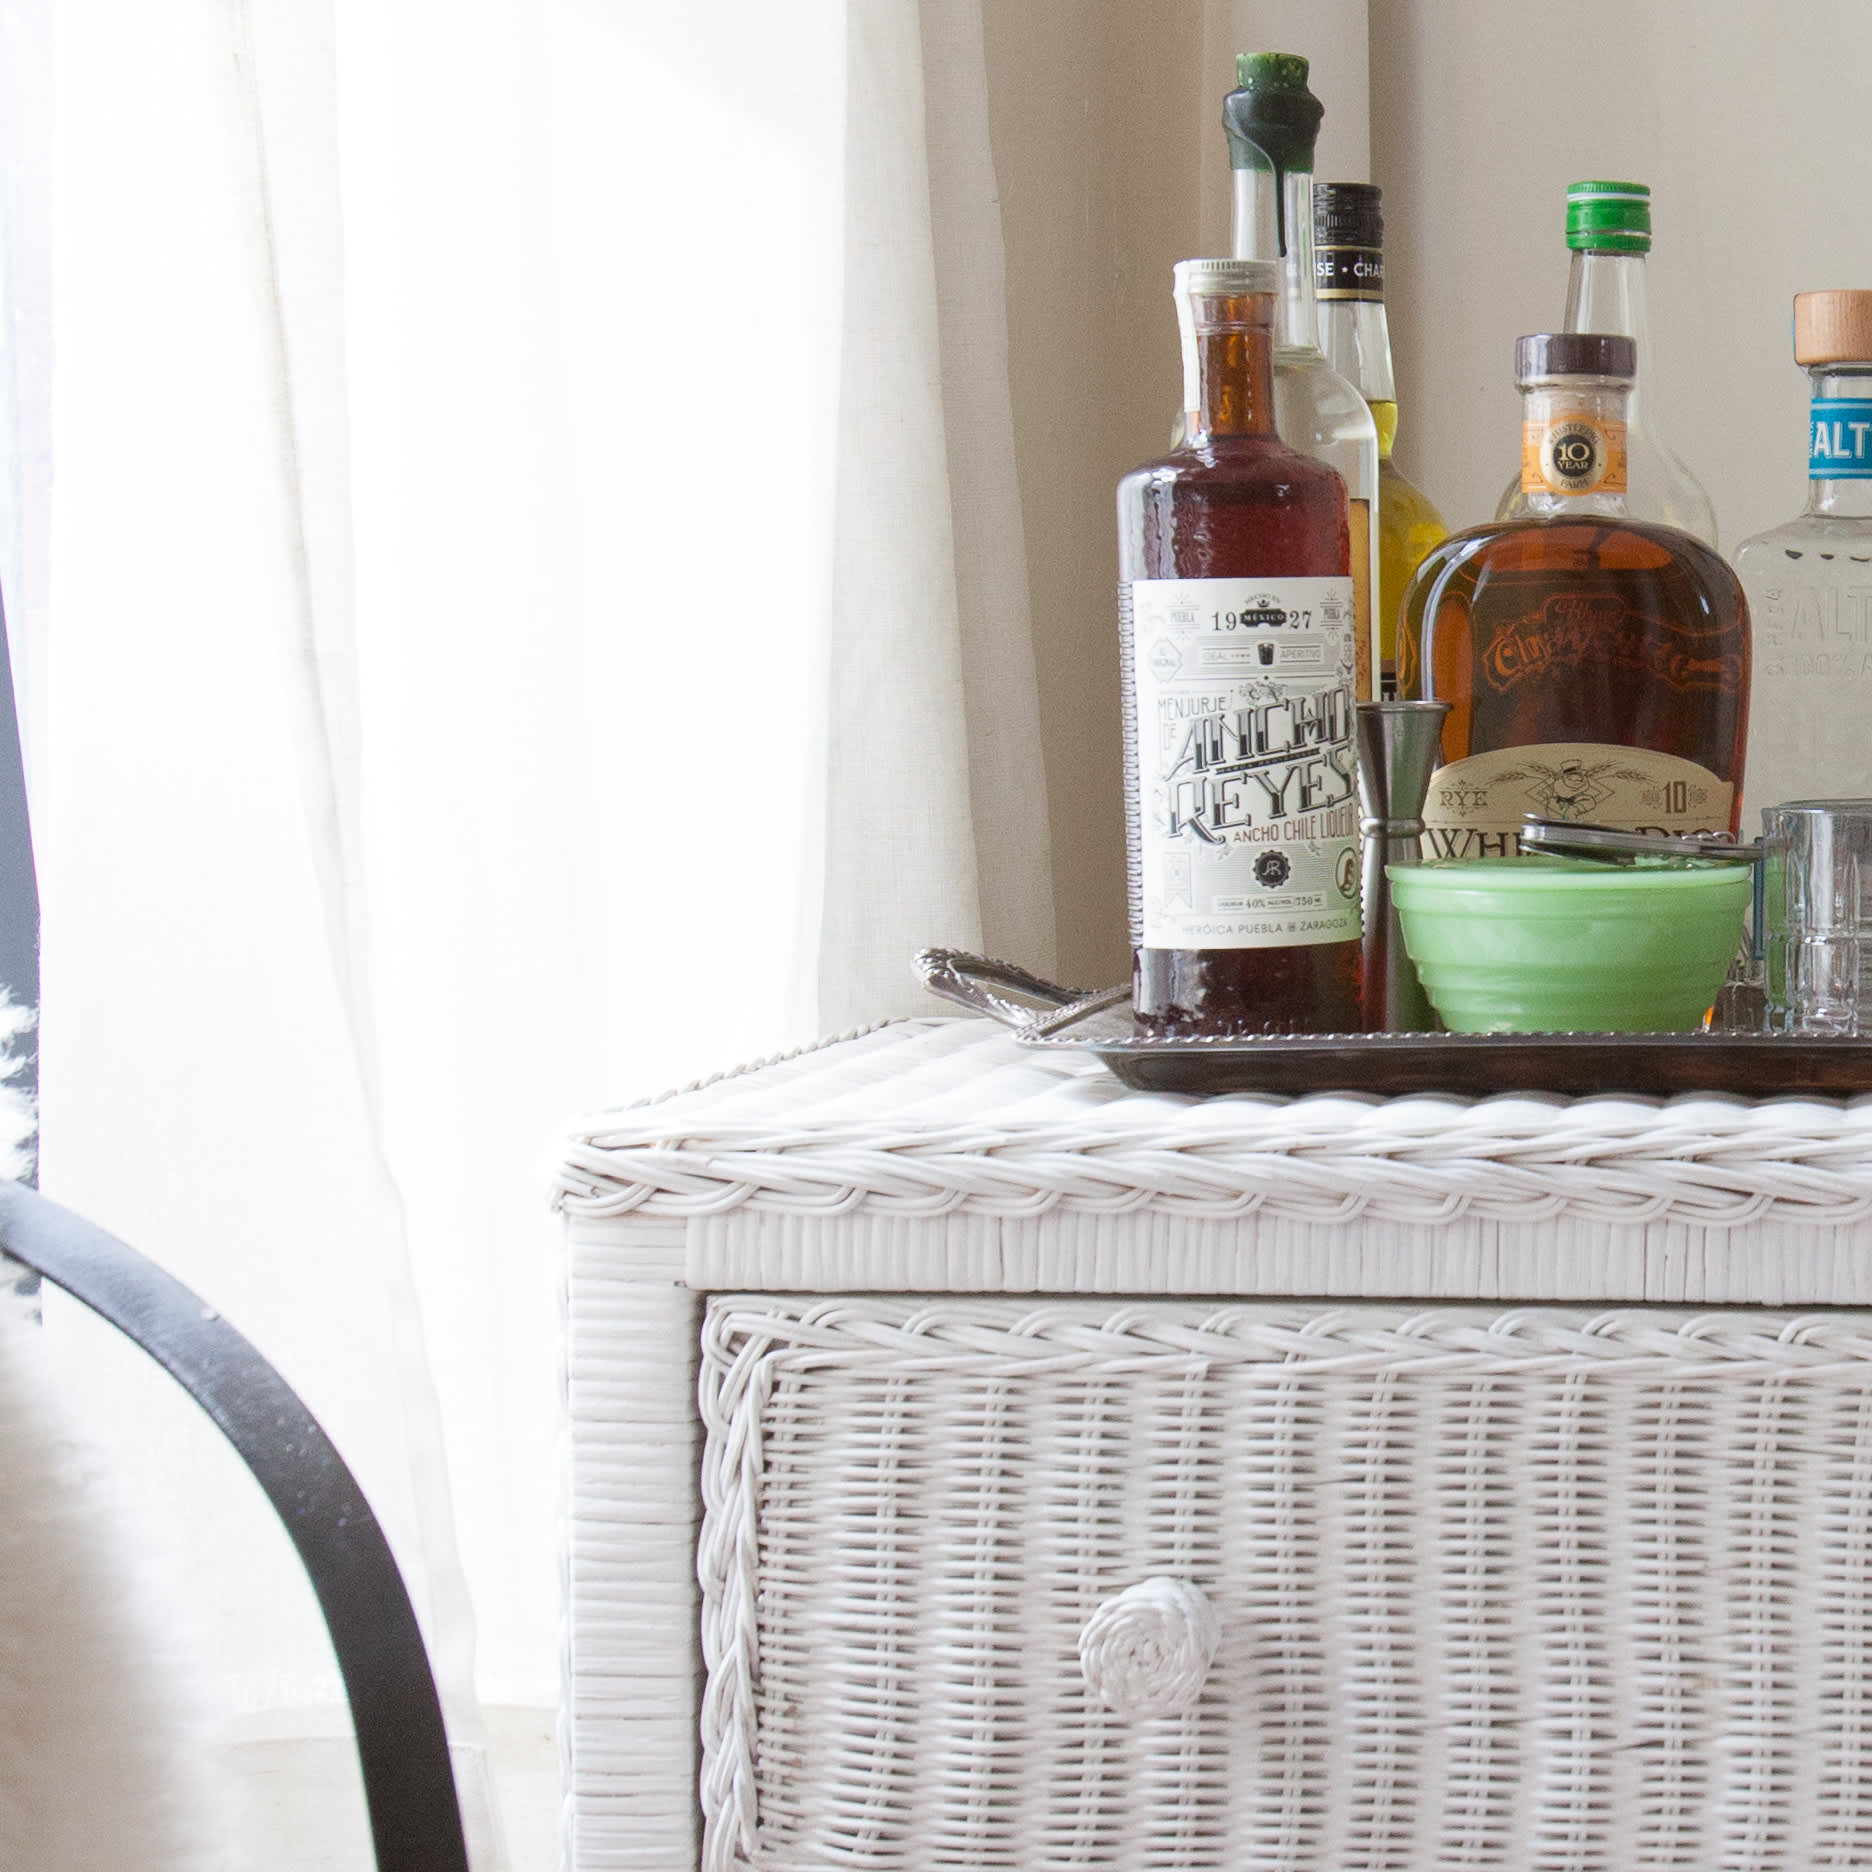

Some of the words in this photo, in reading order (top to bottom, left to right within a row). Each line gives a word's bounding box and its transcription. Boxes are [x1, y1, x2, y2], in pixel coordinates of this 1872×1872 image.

[1558, 442, 1590, 461] 10
[1557, 460, 1589, 470] YEAR
[1211, 611, 1238, 632] 19
[1289, 610, 1312, 630] 27
[1165, 685, 1352, 782] ANCHO
[1167, 744, 1354, 844] REYES
[1439, 789, 1489, 808] RYE
[1664, 781, 1688, 814] 10
[1233, 826, 1280, 843] ANCHO
[1283, 816, 1317, 842] CHILE
[1238, 922, 1283, 935] PUEBLA
